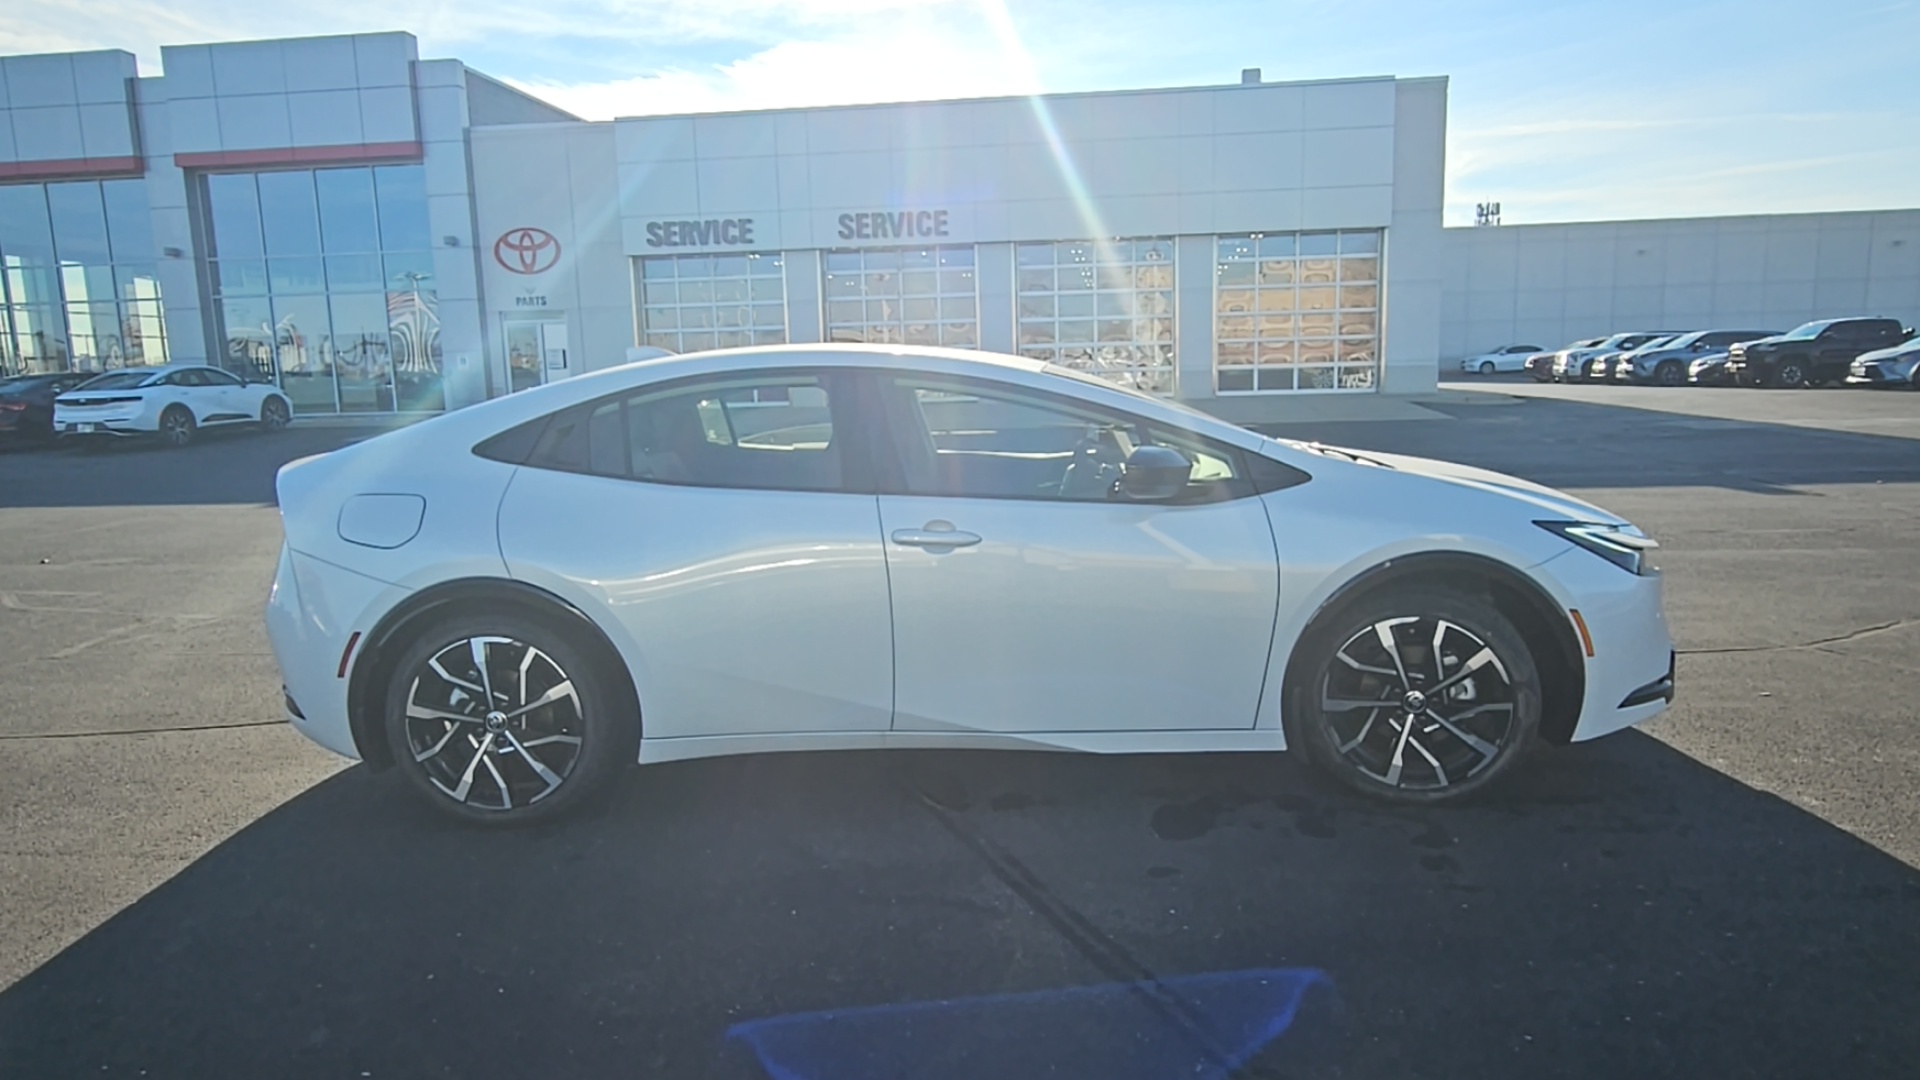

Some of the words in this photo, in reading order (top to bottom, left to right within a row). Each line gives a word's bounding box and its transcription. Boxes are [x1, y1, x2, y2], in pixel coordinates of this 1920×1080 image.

[646, 218, 754, 248] SERVICE
[838, 209, 949, 240] SERVICE
[515, 295, 547, 307] PARTS
